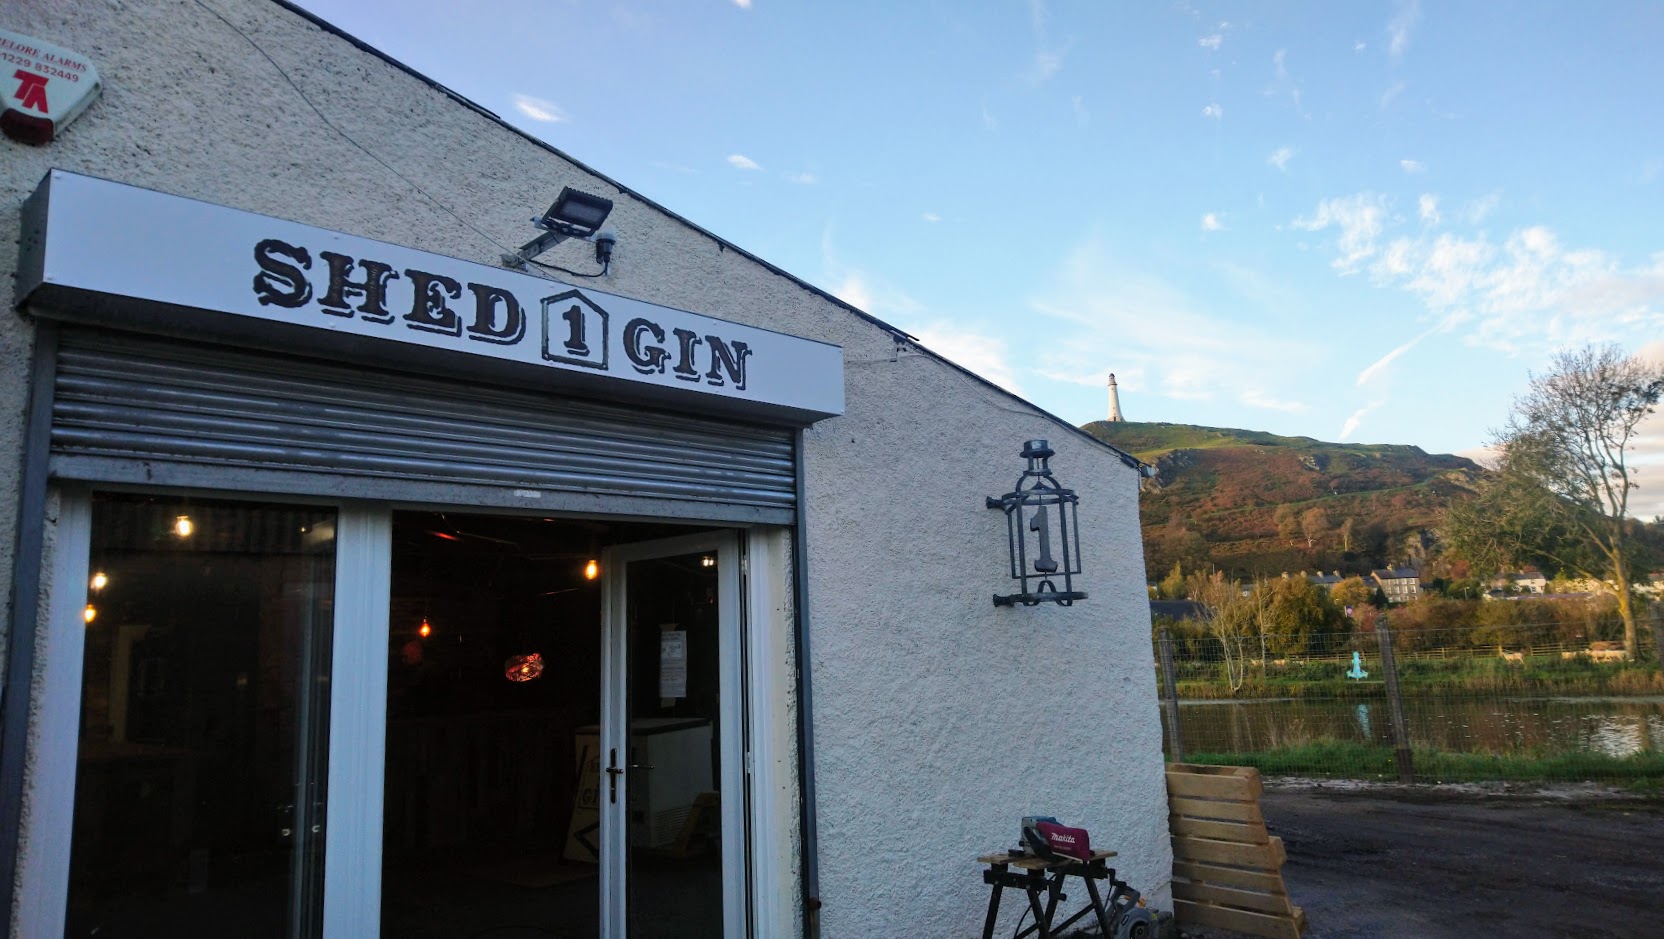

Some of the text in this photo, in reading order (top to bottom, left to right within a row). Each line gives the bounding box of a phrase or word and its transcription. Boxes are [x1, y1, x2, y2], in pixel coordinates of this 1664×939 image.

[0, 38, 87, 72] ELORE ALARMS
[0, 52, 79, 82] 1229 832449
[253, 238, 753, 390] SHED 1 GIN
[1030, 505, 1058, 573] 1
